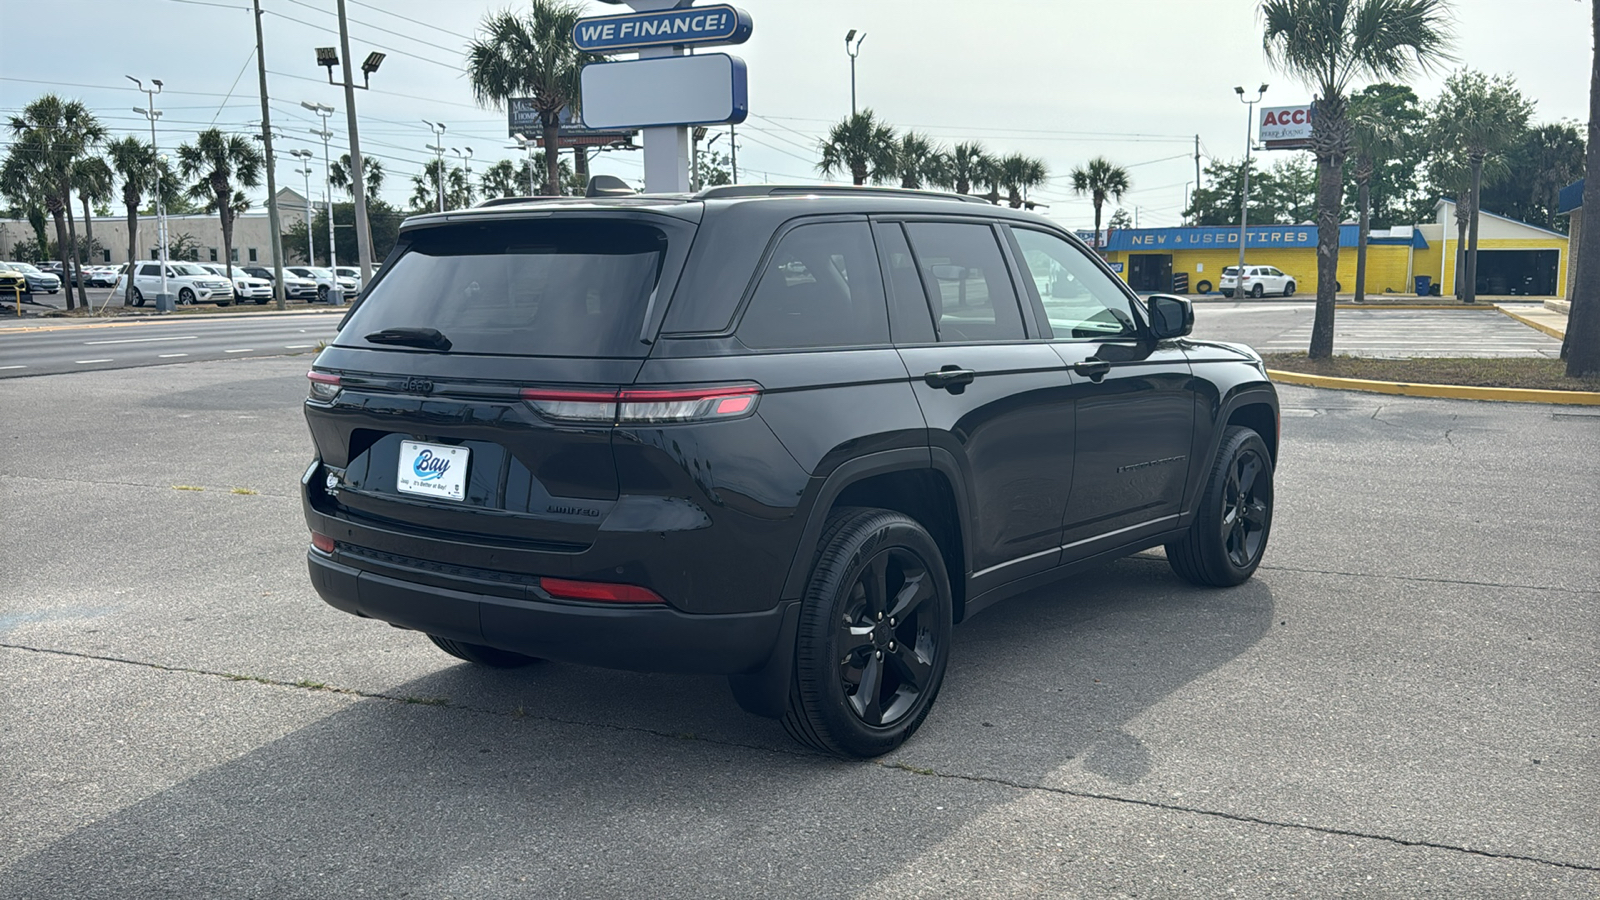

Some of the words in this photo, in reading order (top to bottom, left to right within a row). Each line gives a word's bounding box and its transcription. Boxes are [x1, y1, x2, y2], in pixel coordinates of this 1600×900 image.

[581, 24, 616, 41] WE
[620, 14, 728, 39] FINANCE!
[1132, 235, 1167, 245] NEW
[1174, 235, 1182, 243] &
[1190, 232, 1238, 244] USED
[1246, 231, 1308, 243] TIRES
[416, 449, 451, 479] Bay
[547, 505, 600, 517] LIMITED
